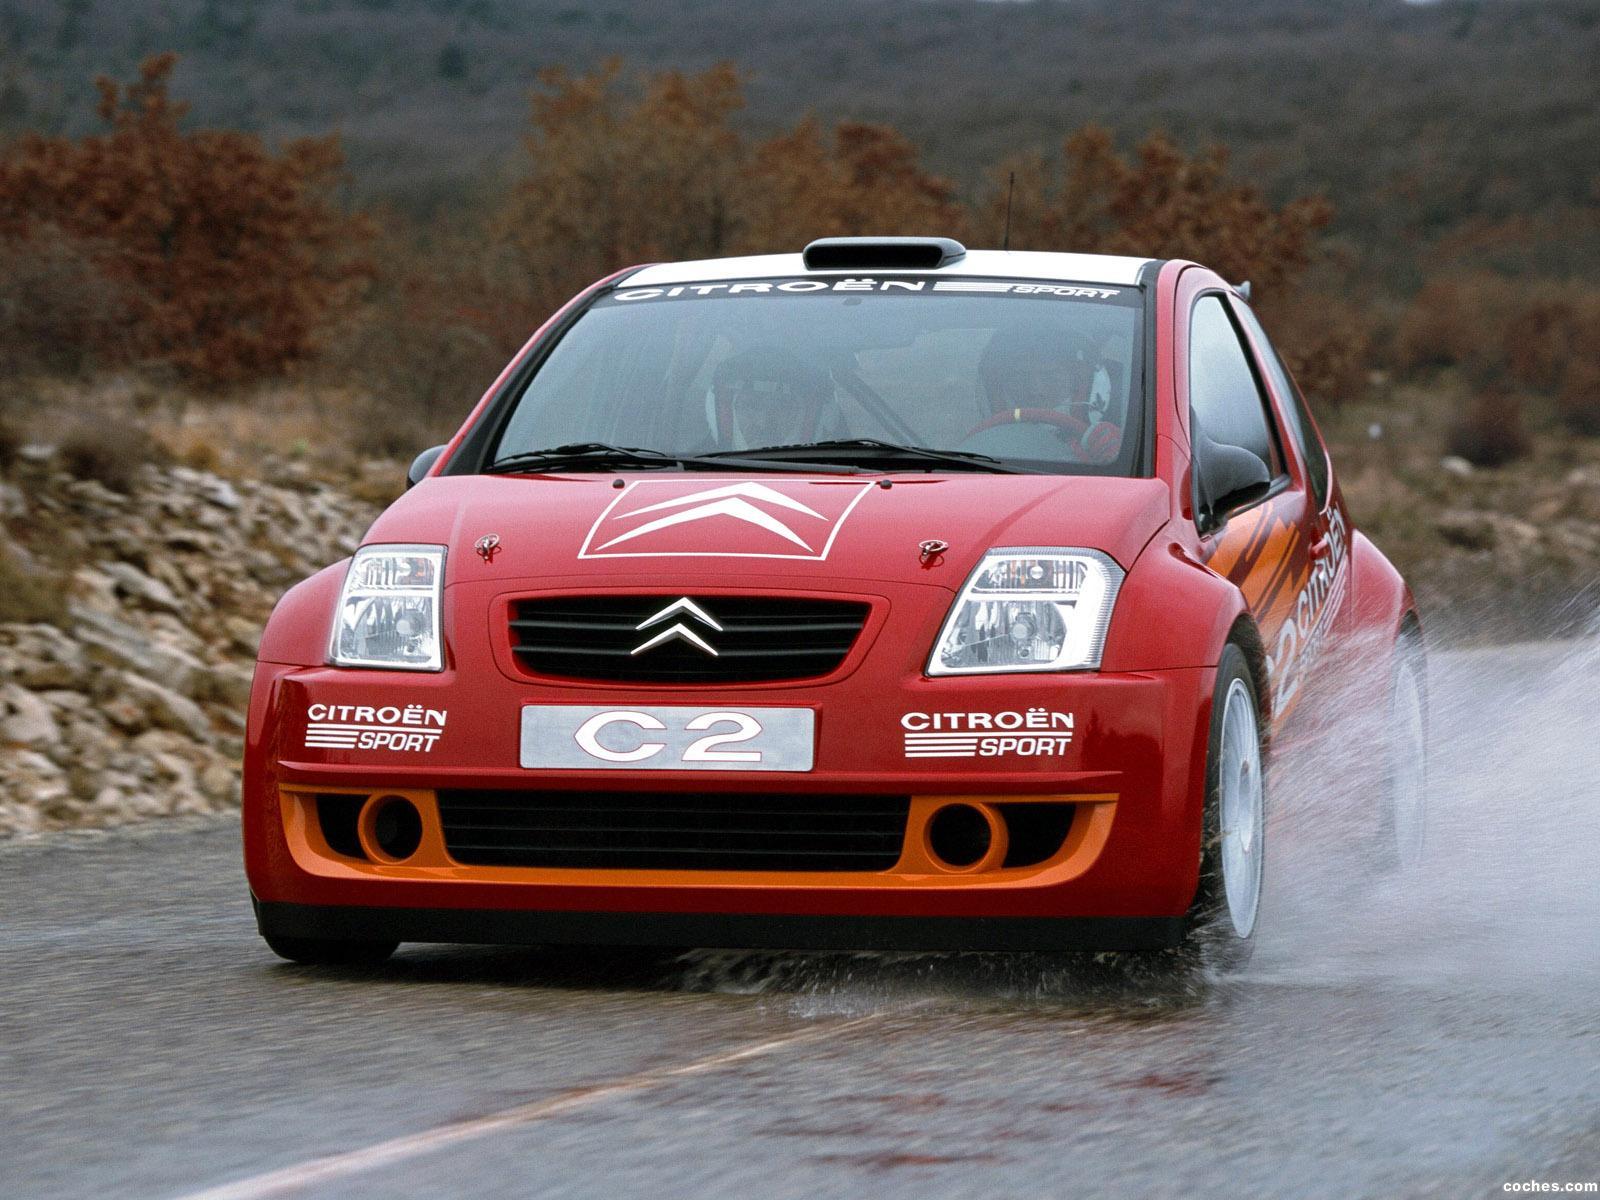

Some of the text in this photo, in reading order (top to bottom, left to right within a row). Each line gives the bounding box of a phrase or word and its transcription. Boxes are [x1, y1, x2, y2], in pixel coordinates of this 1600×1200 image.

[614, 278, 1120, 300] CITROËN SPORT
[307, 703, 447, 726] CITROËN
[900, 707, 1074, 730] CITROËN
[358, 731, 440, 752] SPORT
[574, 710, 763, 762] C2
[979, 738, 1072, 756] SPORT
